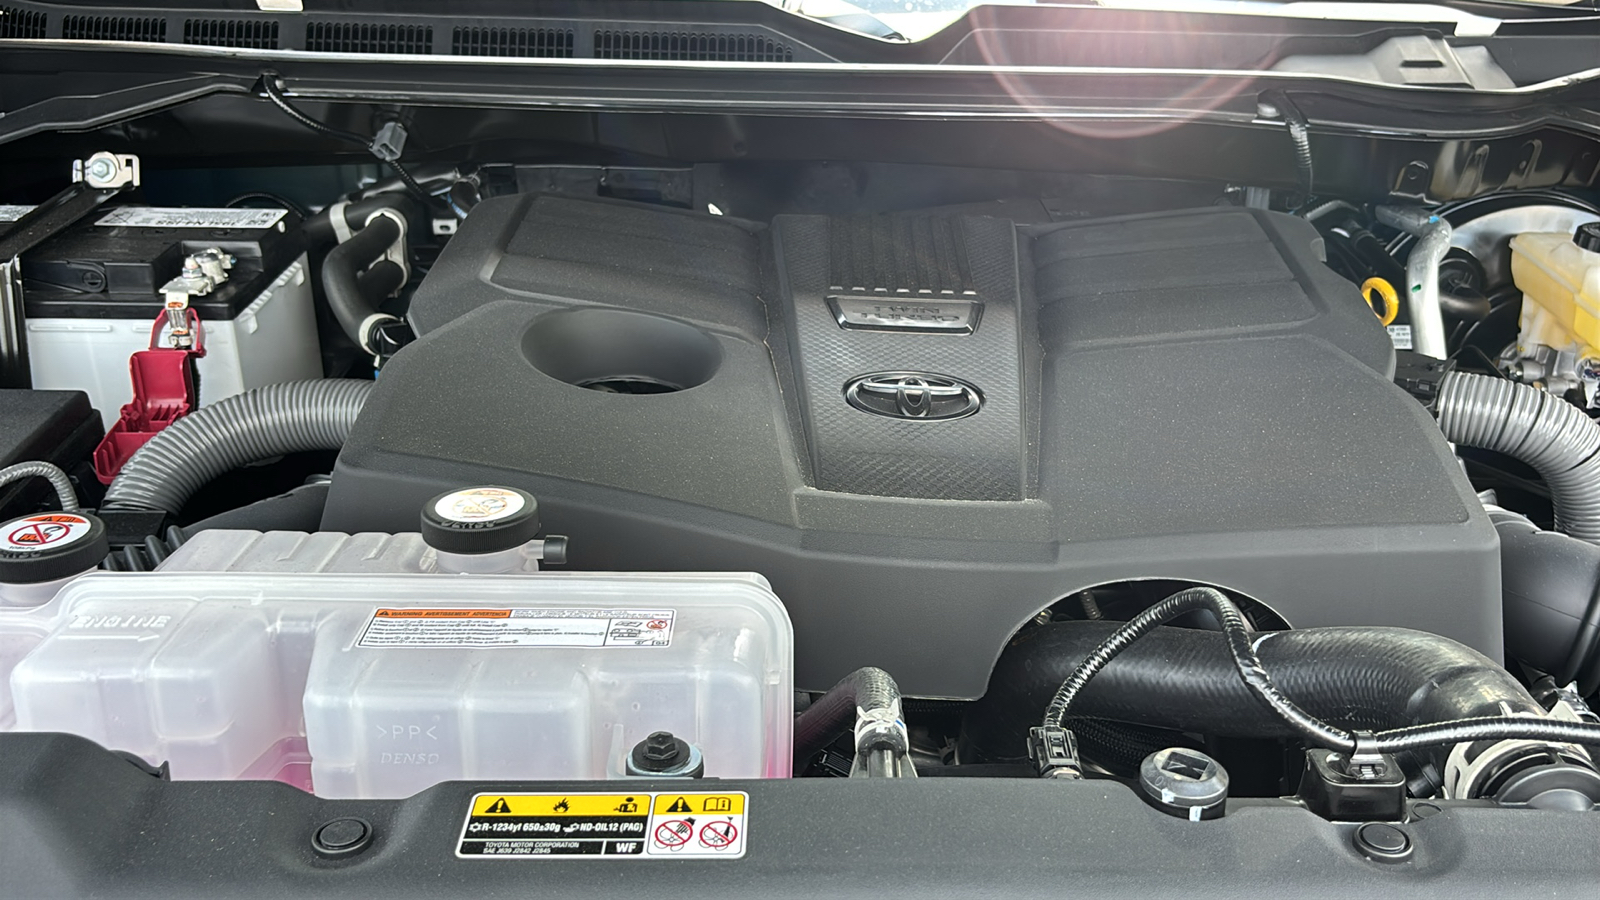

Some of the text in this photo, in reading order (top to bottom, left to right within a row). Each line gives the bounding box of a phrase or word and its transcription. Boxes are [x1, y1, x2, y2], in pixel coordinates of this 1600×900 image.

[868, 305, 940, 314] TWIN
[68, 615, 171, 629] ENGINE
[380, 752, 440, 765] DENSO
[482, 822, 643, 833] R-1234yf 650±30g ND-OIL12 (PAG)
[616, 842, 636, 853] WF
